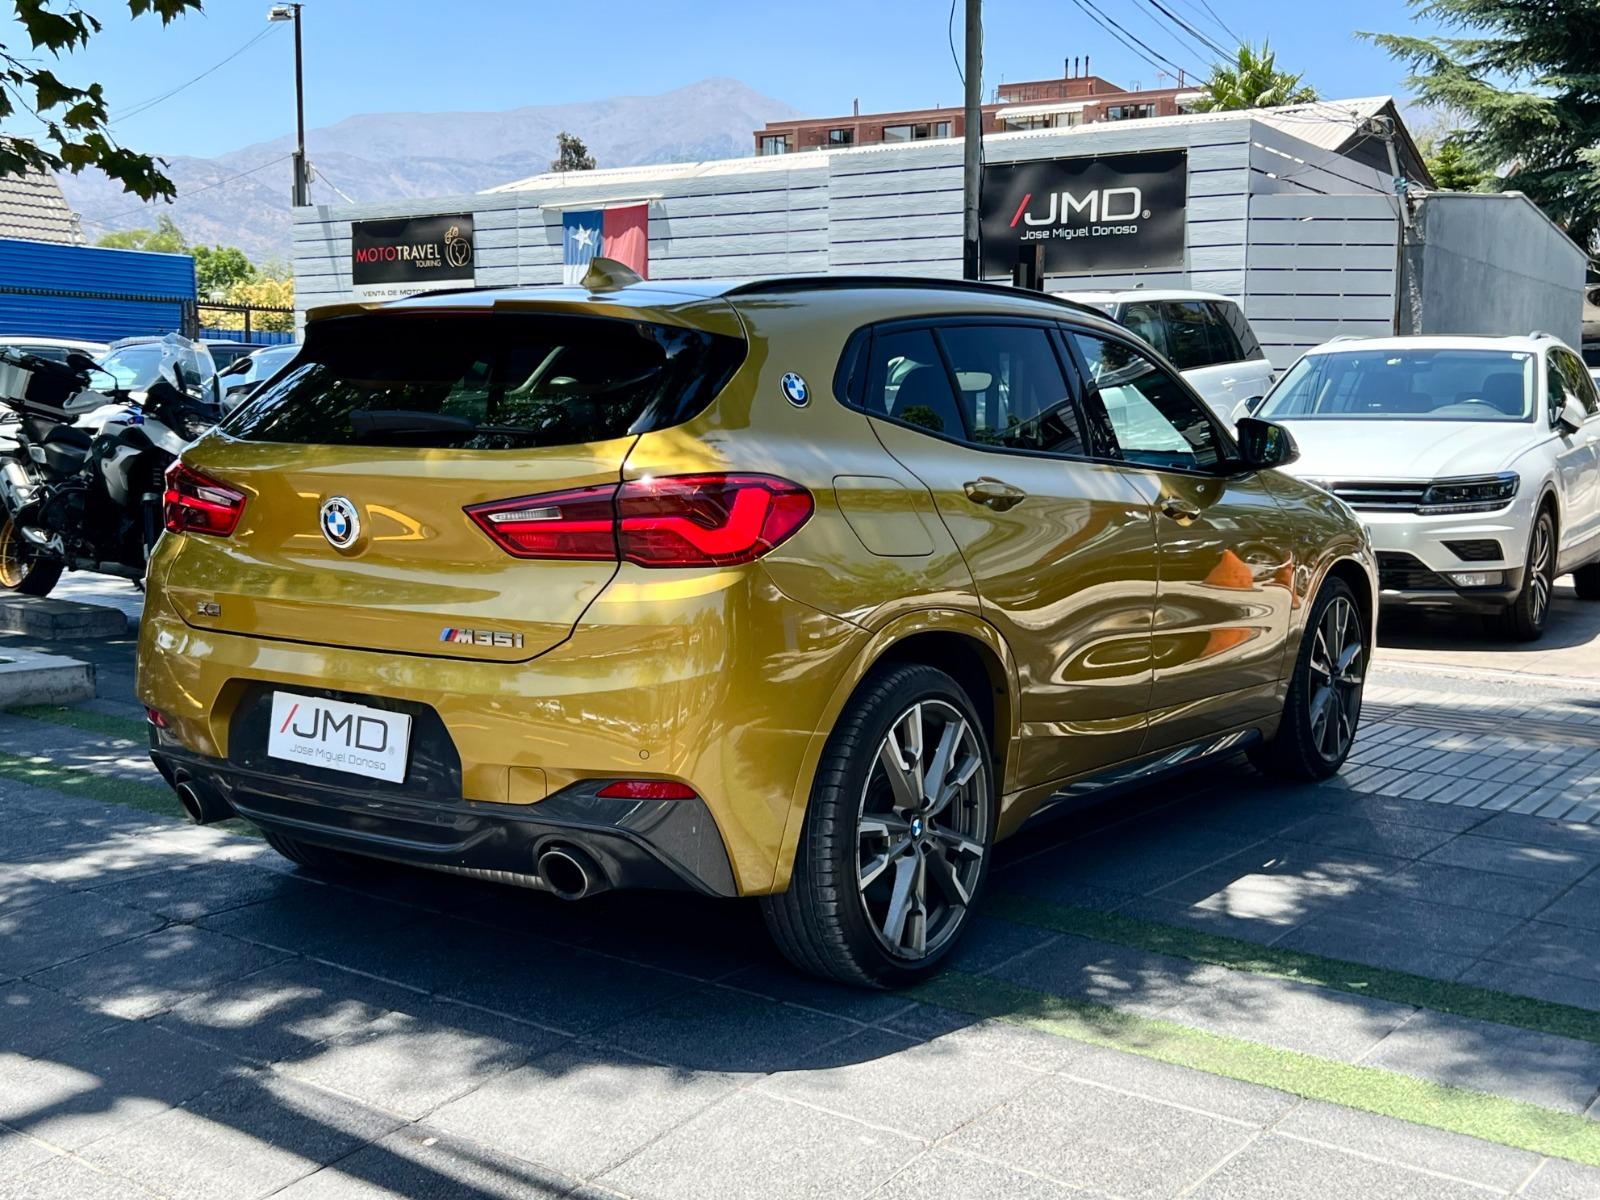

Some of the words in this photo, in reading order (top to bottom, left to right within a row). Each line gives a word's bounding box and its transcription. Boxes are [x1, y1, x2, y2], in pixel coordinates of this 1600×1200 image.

[1020, 229, 1050, 240] Jose
[1052, 226, 1089, 240] Miguel
[1091, 225, 1138, 236] Donoso
[356, 244, 441, 263] MOTOTRAVEL
[416, 260, 442, 268] TOURING
[289, 743, 314, 757] Jose
[315, 747, 346, 763] Miguel
[348, 754, 387, 771] Donoso
